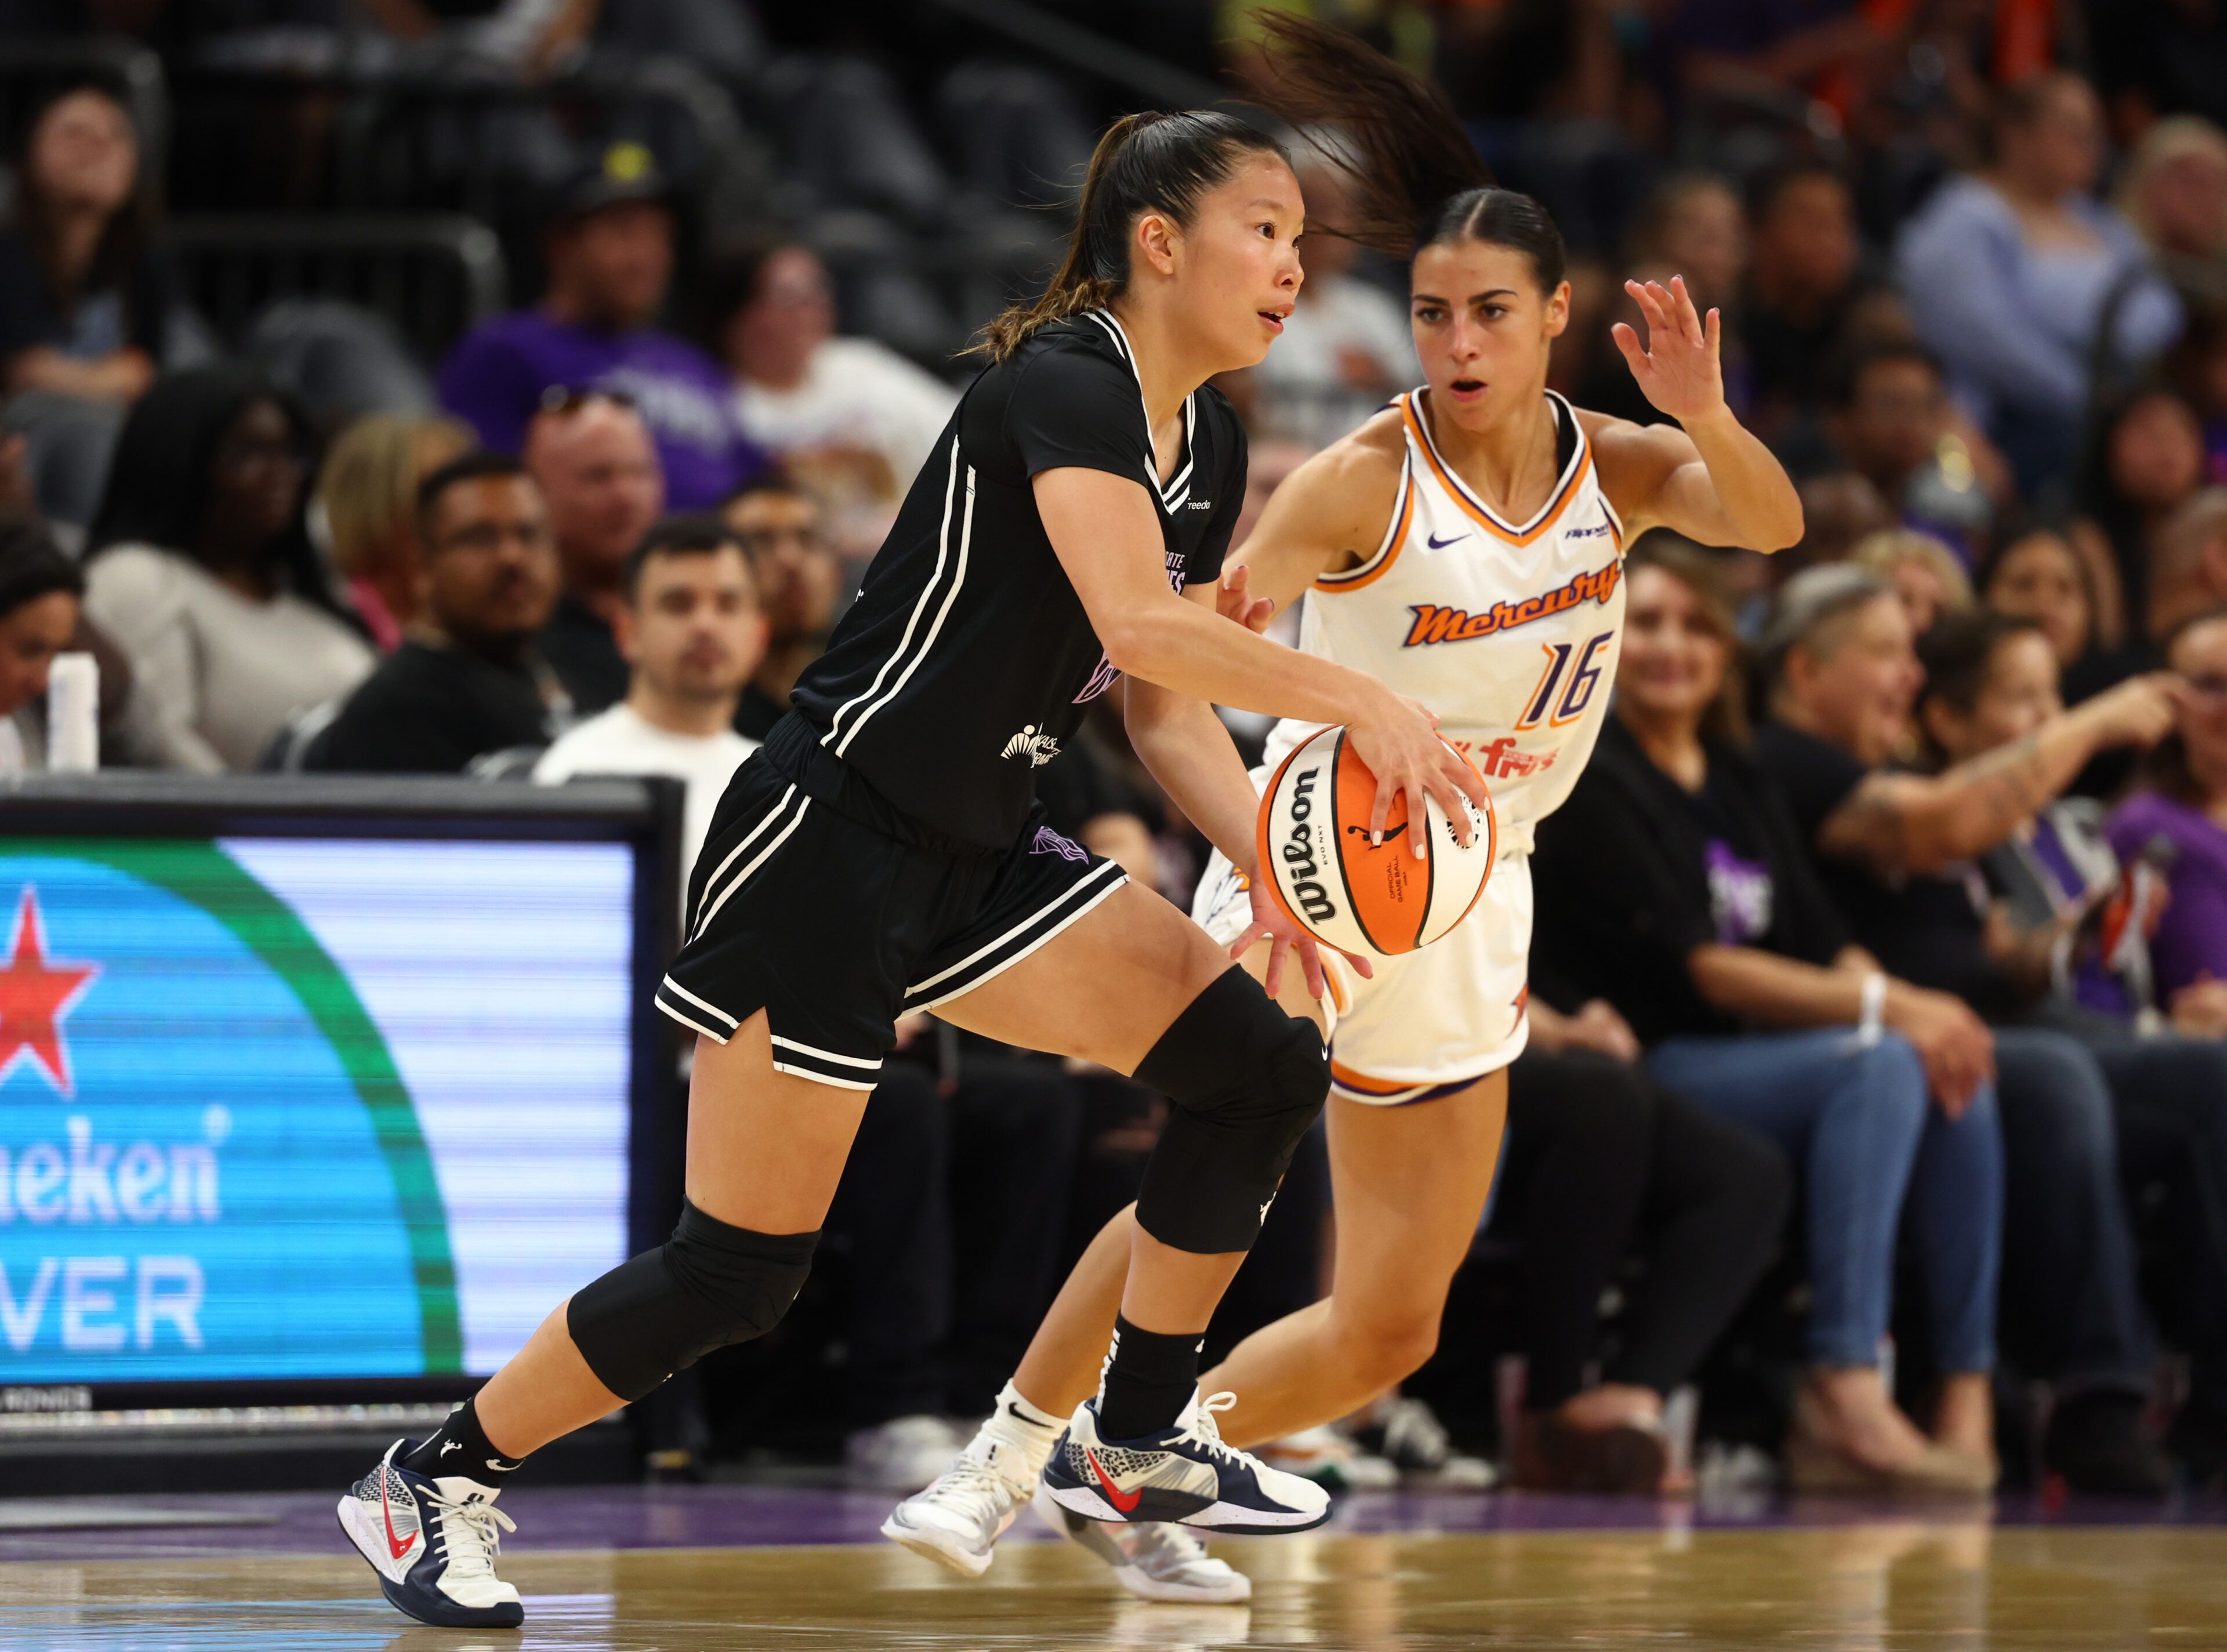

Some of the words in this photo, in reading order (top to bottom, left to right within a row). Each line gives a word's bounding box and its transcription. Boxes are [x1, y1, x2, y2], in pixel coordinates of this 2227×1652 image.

[1403, 558, 1622, 647] Mercury
[1514, 629, 1615, 731] 16
[1282, 766, 1337, 926] Wilson
[1319, 846, 1328, 866] EVO
[1387, 862, 1395, 899] OFFICIAL
[1392, 855, 1401, 878] BALL
[1395, 879, 1403, 903] GAME
